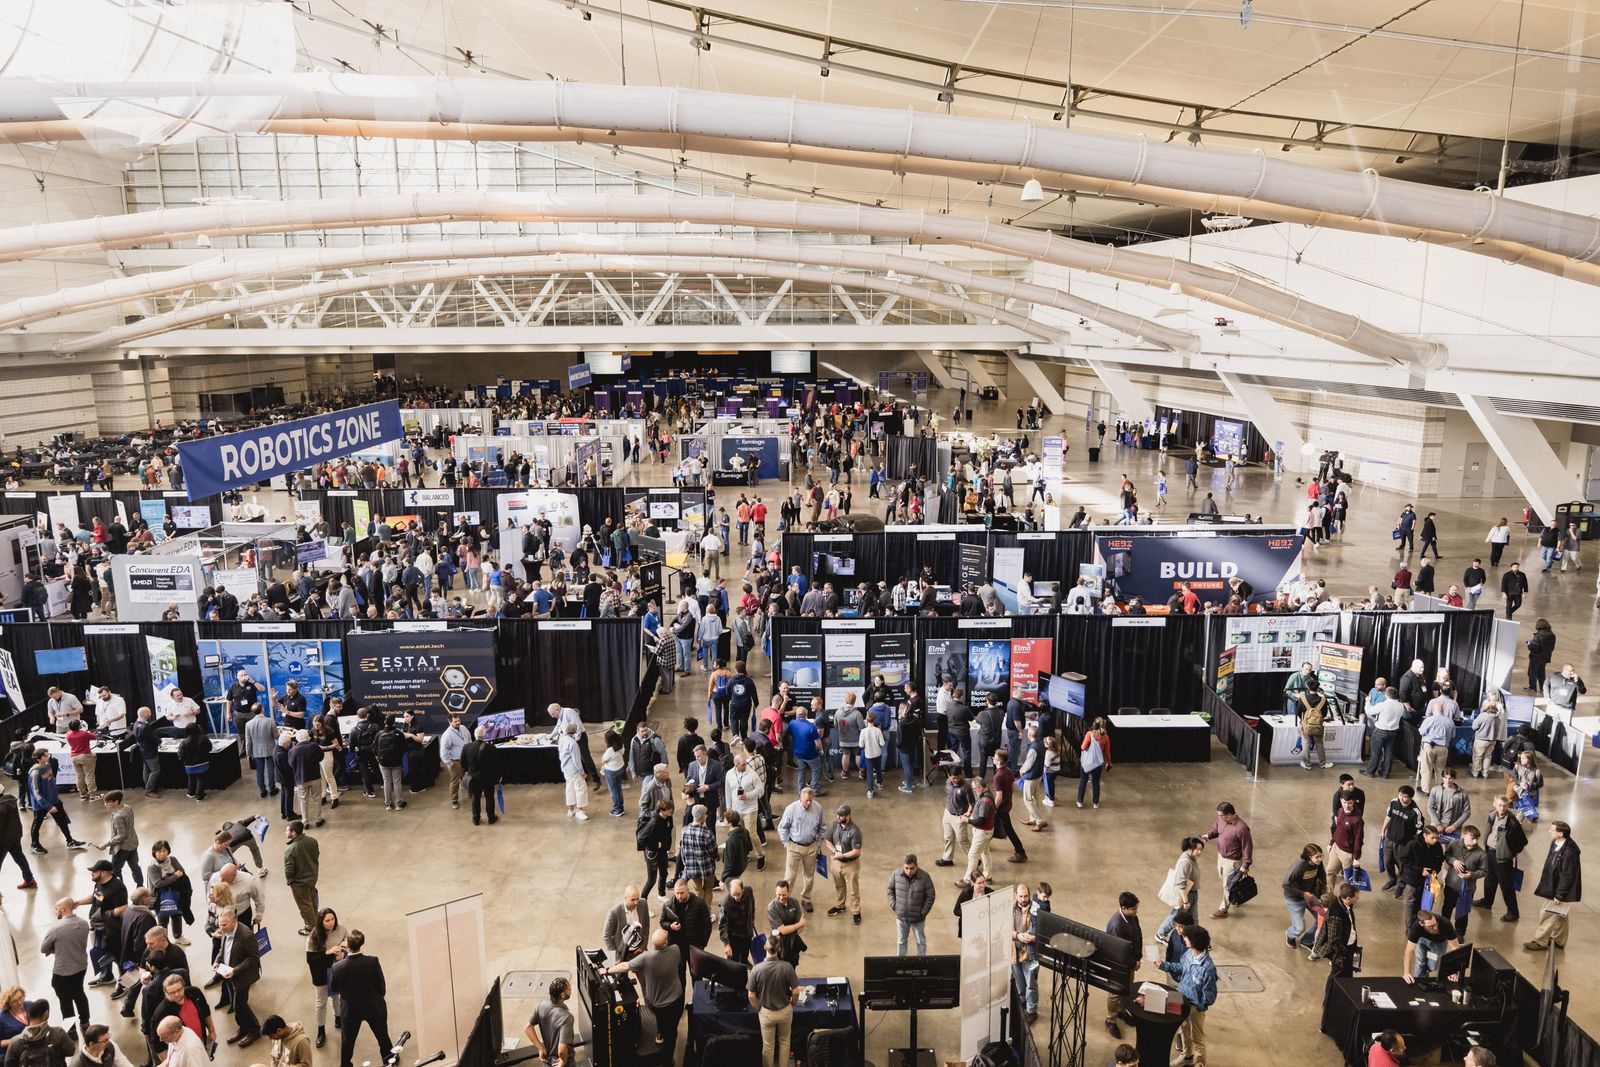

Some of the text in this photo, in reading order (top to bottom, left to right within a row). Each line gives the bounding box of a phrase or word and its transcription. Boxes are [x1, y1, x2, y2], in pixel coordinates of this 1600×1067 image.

[220, 411, 382, 481] ROBOTICS ZONE
[129, 565, 191, 574] Concurrent EDA
[1160, 561, 1239, 579] BUILD
[381, 655, 440, 667] ESTAT
